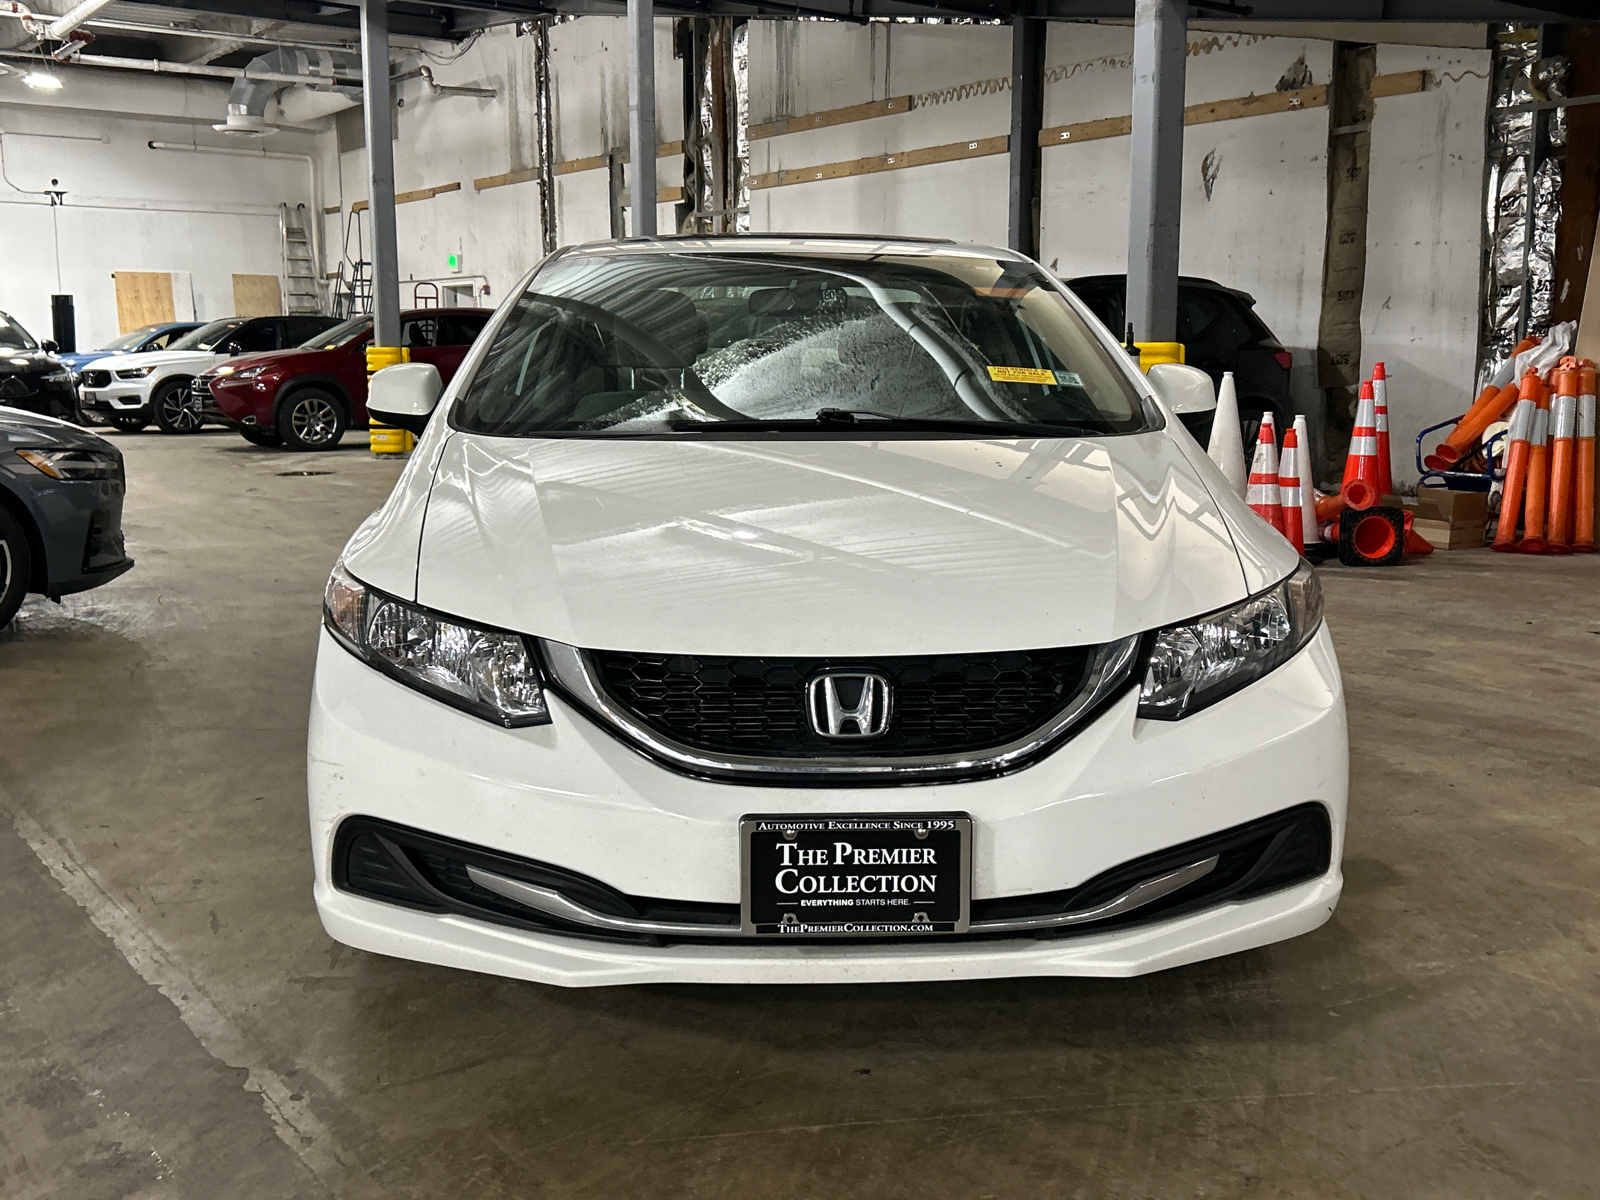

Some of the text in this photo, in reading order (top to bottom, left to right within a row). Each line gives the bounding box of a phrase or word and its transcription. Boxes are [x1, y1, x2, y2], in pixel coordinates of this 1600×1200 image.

[758, 820, 955, 830] AUTOMOTIVE EXCELLENCE SINCE 1995
[775, 842, 937, 866] THE PREMIER
[775, 868, 937, 894] COLLECTION
[800, 899, 854, 907] EVERYTHING
[887, 898, 911, 906] HERE.
